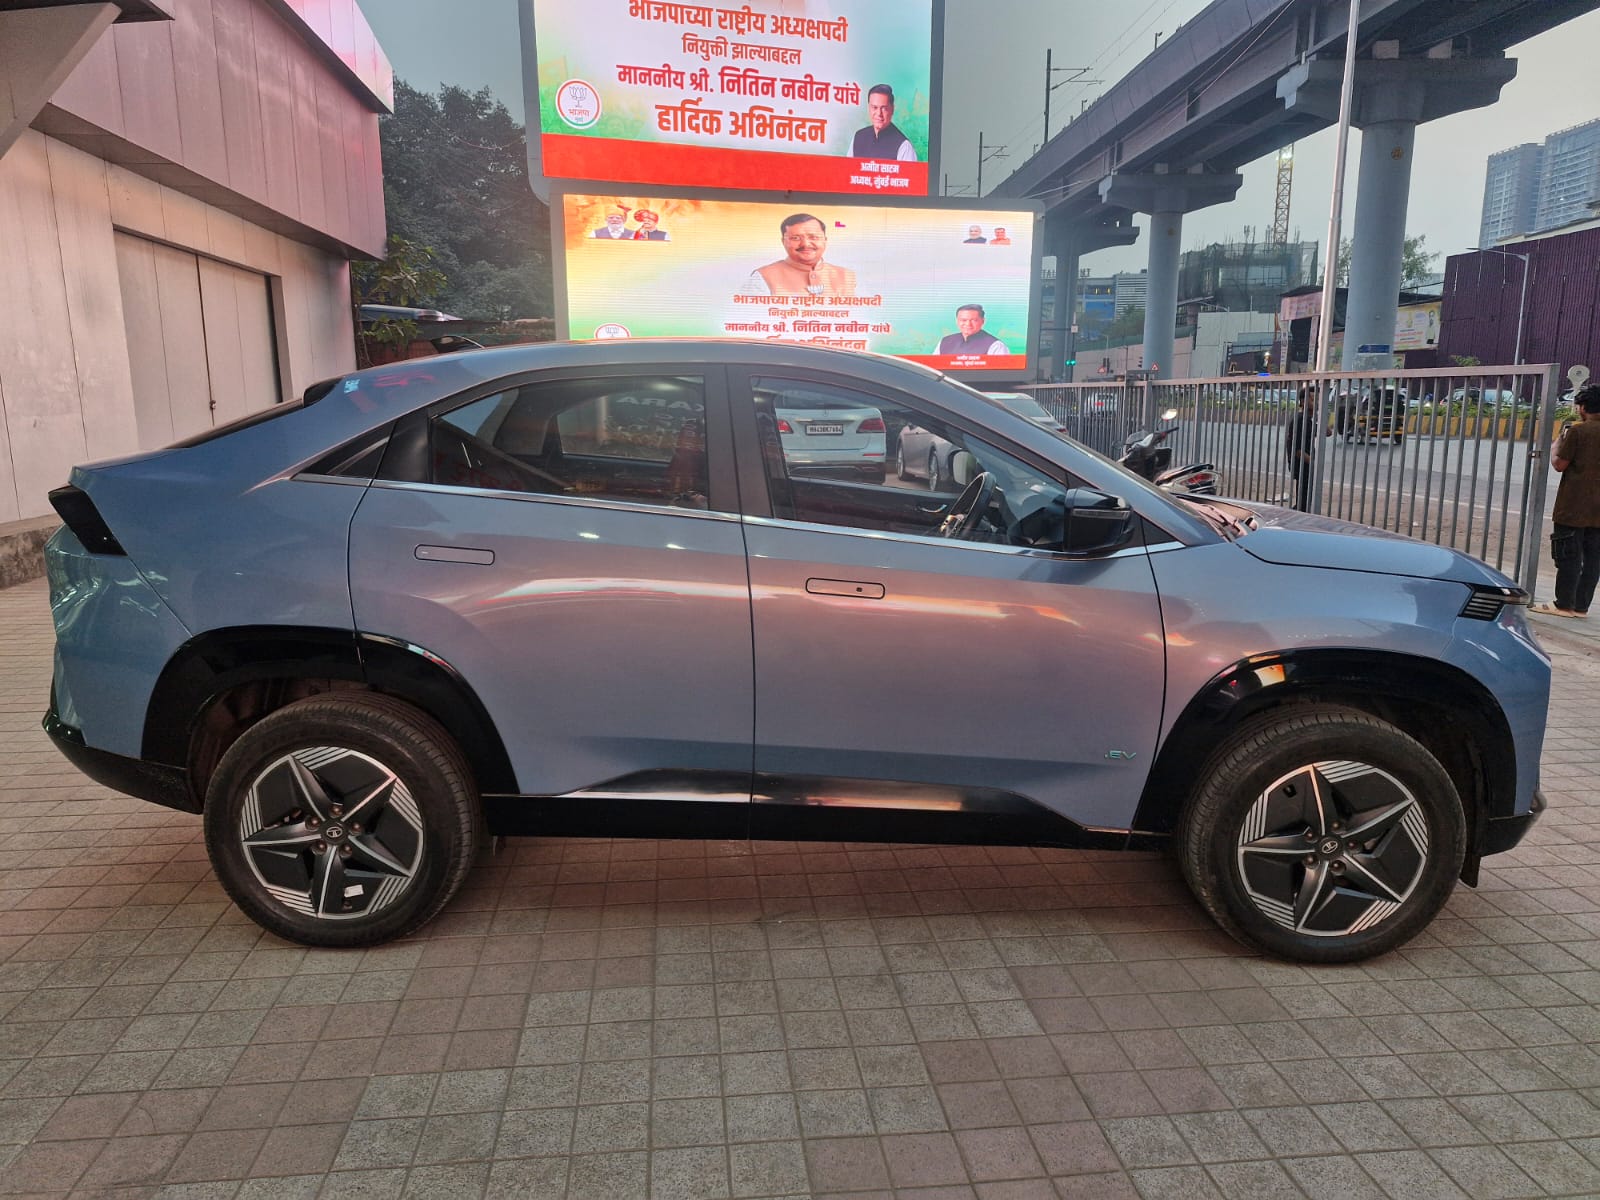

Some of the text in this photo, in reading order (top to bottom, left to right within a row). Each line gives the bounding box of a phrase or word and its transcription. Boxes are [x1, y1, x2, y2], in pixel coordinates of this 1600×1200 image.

[629, 0, 849, 42] भाजपाच्या राष्ट्रीय अध्यक्षपदी
[681, 32, 802, 65] नियुक्ती झाल्याबद्दल
[616, 63, 686, 90] माननीय
[718, 66, 777, 98] नितिन
[780, 73, 831, 103] नबीन
[833, 82, 861, 106] यांचे
[655, 96, 828, 144] हार्दिक अभिनंदन
[733, 294, 882, 306] भाजपाच्या राष्ट्रीय अध्यक्षपदी
[724, 321, 770, 333] माननीय
[792, 320, 832, 333] नितिन
[834, 321, 869, 333] नबीन
